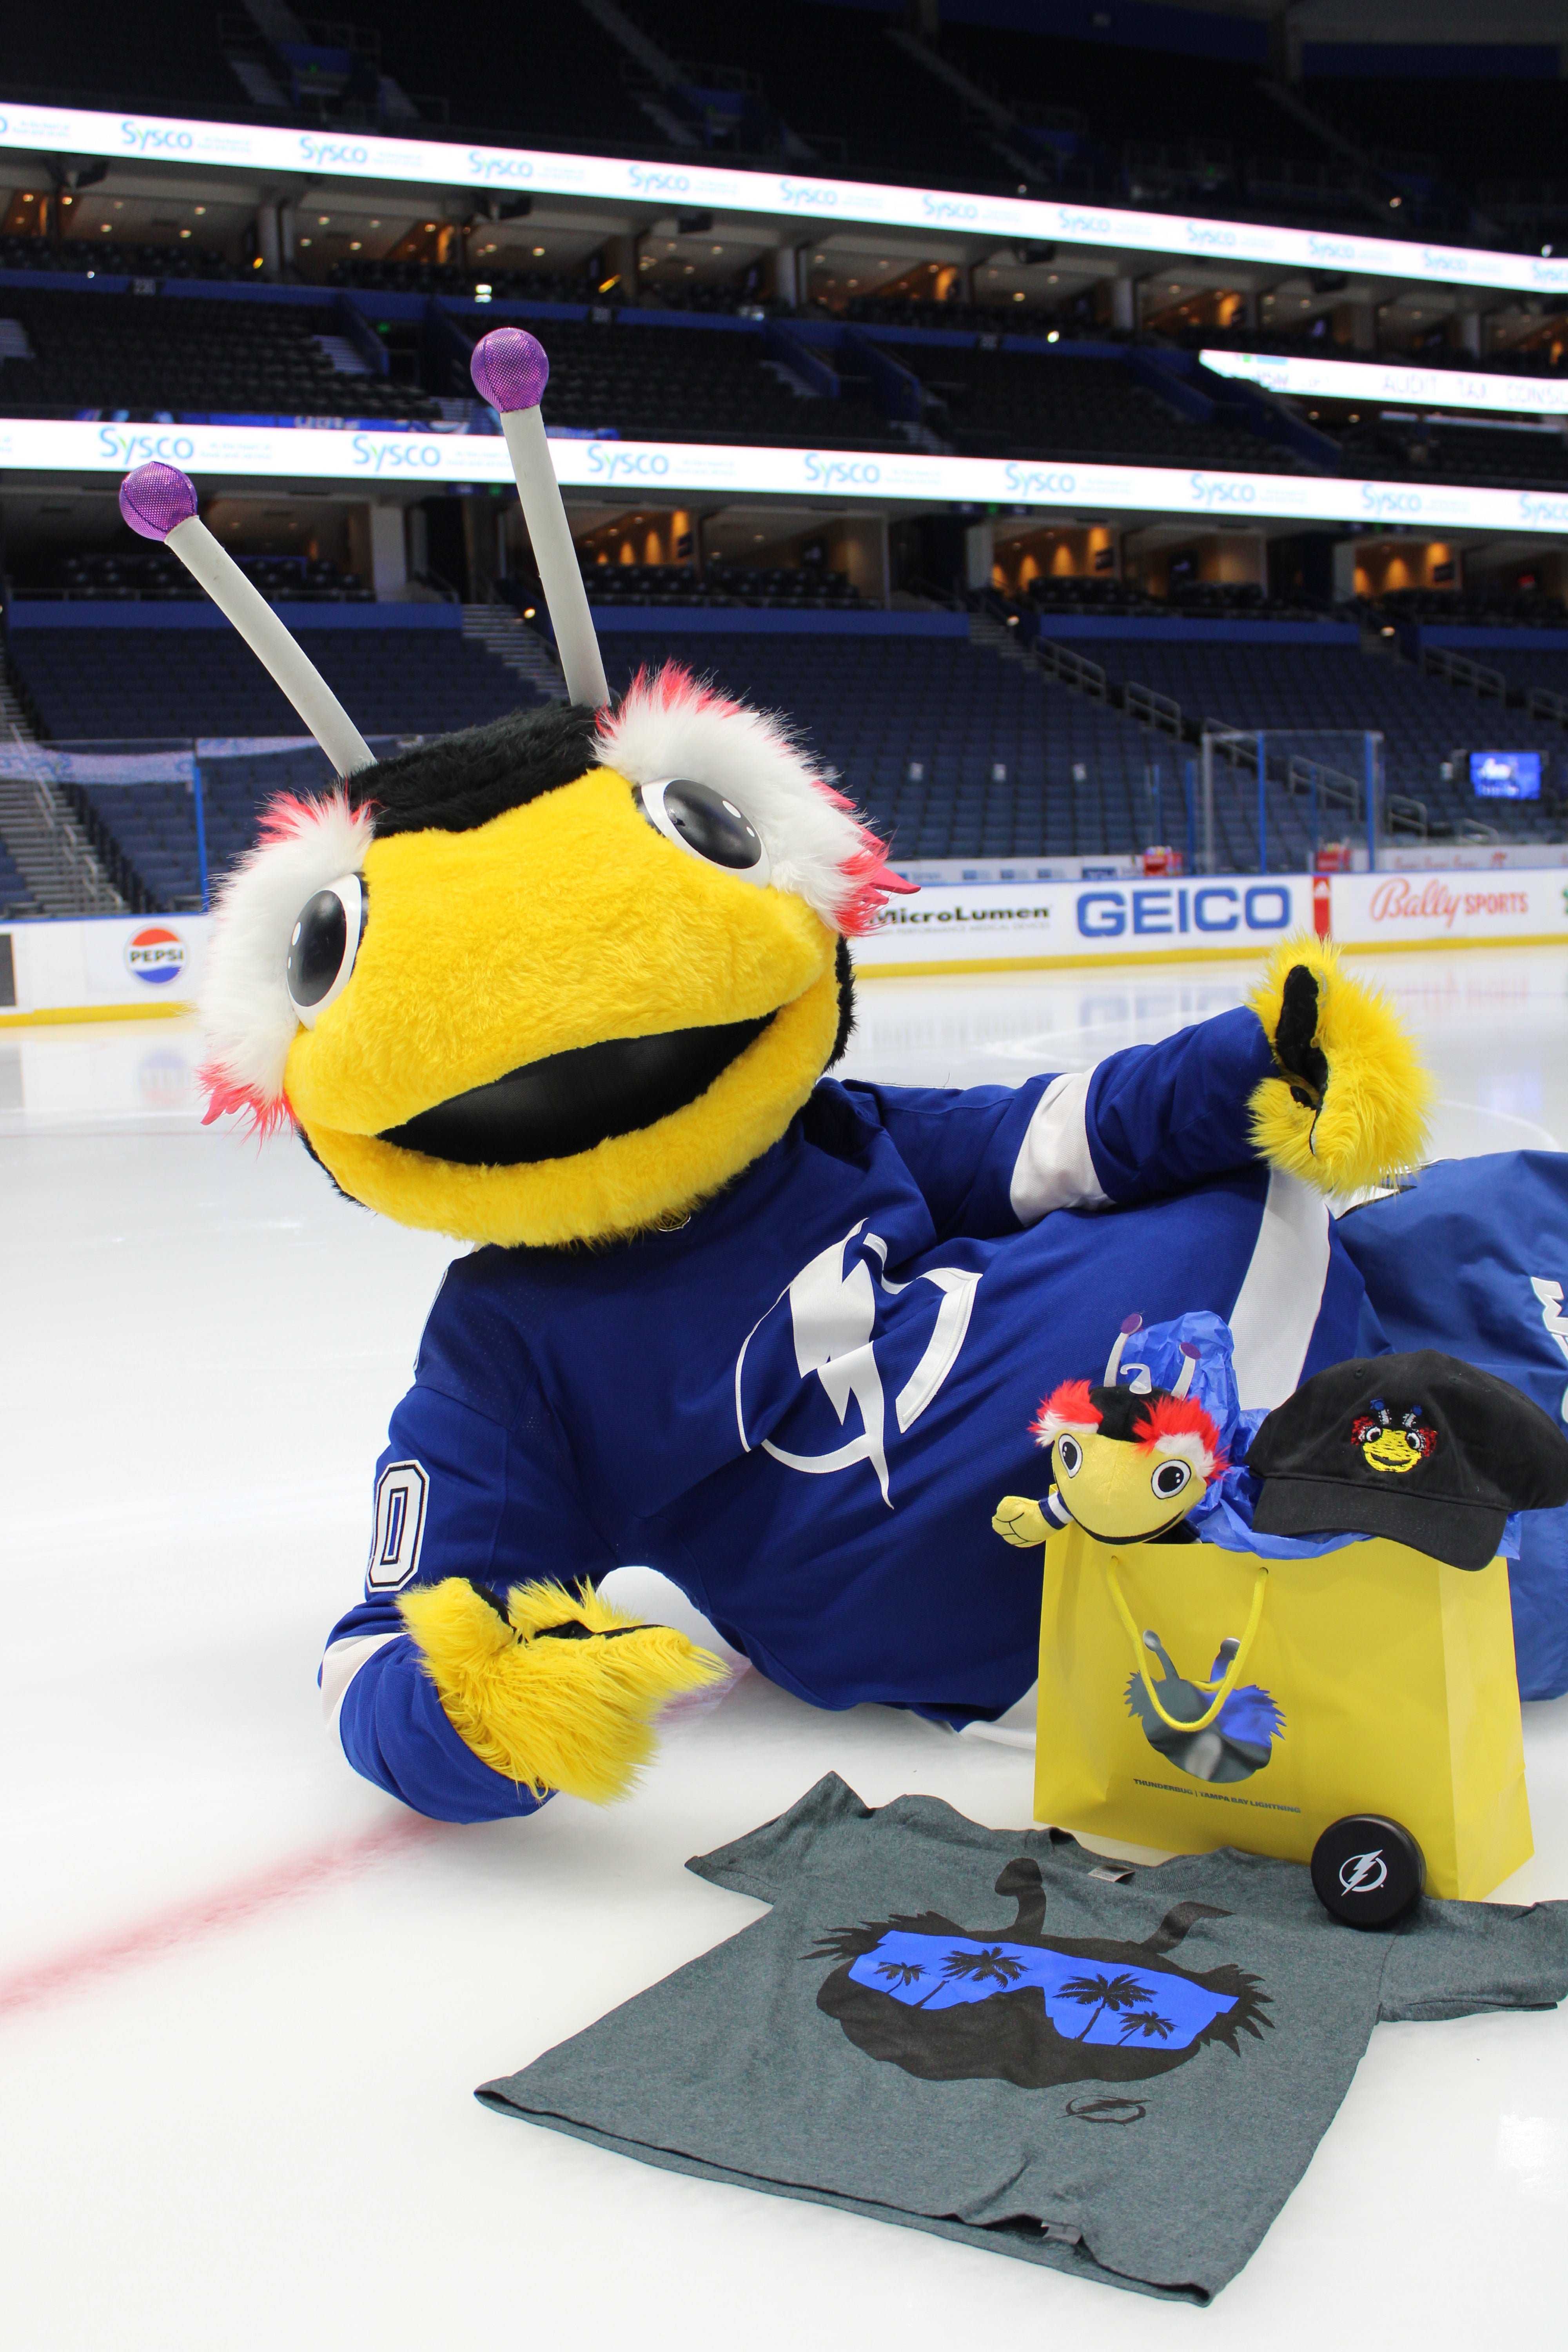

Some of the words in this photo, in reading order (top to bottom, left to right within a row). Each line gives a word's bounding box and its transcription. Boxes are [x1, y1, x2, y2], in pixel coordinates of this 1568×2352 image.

[121, 120, 192, 150] Sysco
[299, 136, 367, 164] Sysco
[468, 151, 533, 178] Sysco
[628, 165, 689, 191] Sysco
[780, 180, 837, 205] Sysco
[923, 194, 977, 219] Sysco
[1058, 209, 1110, 232] Sysco
[1187, 222, 1235, 245] Sysco
[1309, 236, 1354, 258] Sysco
[1424, 249, 1466, 271] Sysco
[1532, 261, 1568, 283] Sysc
[98, 425, 194, 465] Sysco
[352, 434, 441, 472] Sysco
[587, 444, 669, 479] Sysco
[804, 452, 880, 486] Sysco
[1005, 463, 1075, 495] Sysco
[1191, 473, 1255, 504] Sysco
[1362, 483, 1421, 513] Sysco
[1076, 885, 1291, 937] GEICO
[1370, 878, 1461, 929] Bally
[1465, 892, 1528, 915] SPORTS
[130, 949, 184, 962] PEPSI
[1133, 1779, 1193, 1795] THUNDERBUG
[1198, 1791, 1231, 1802] TAMPA
[1231, 1797, 1249, 1805] BAY
[1250, 1800, 1301, 1813] LIGHTNING
